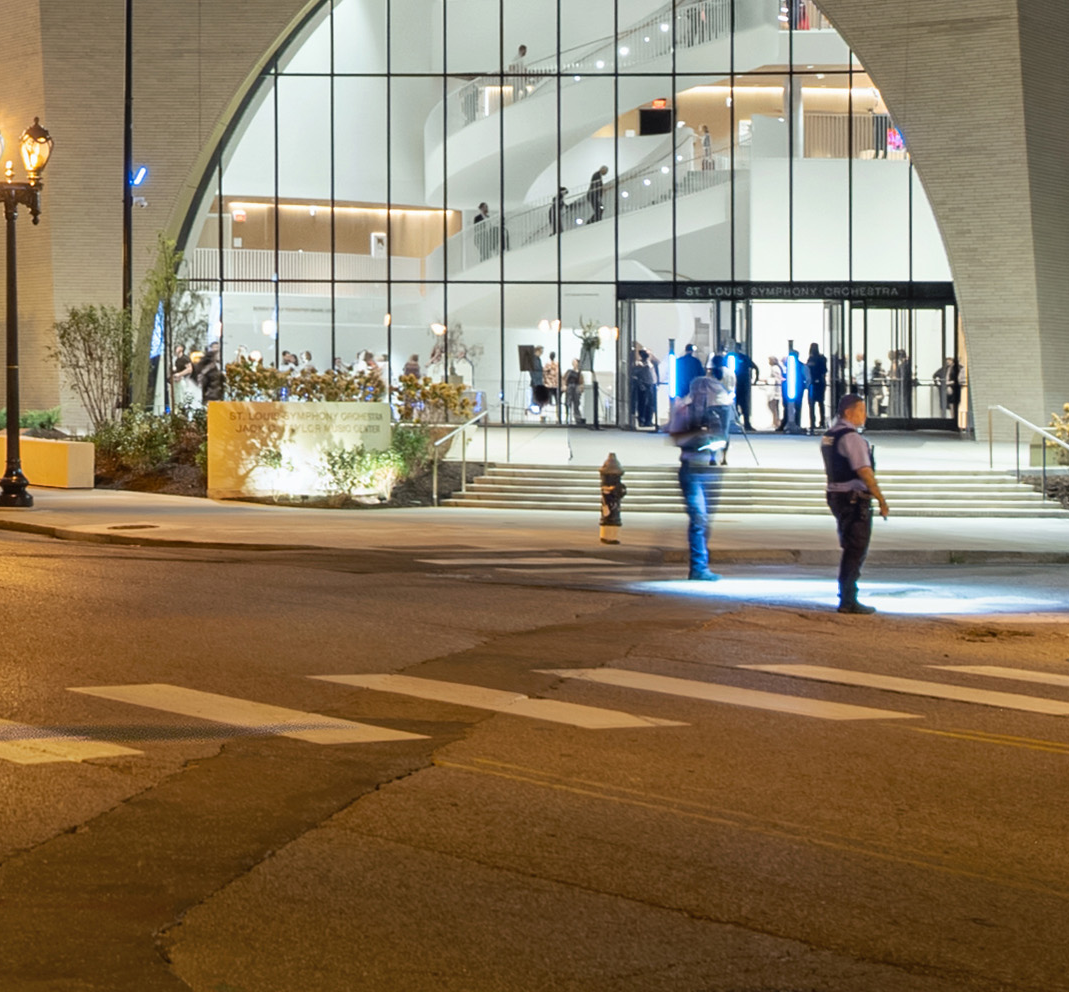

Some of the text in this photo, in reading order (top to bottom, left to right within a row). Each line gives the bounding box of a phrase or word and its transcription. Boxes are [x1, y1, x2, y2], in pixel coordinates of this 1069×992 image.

[708, 286, 744, 297] LOUIS
[750, 286, 817, 297] SYMPHONY
[823, 286, 899, 297] ORCHESTRA
[230, 411, 245, 421] ST.
[248, 411, 281, 421] LOUIS
